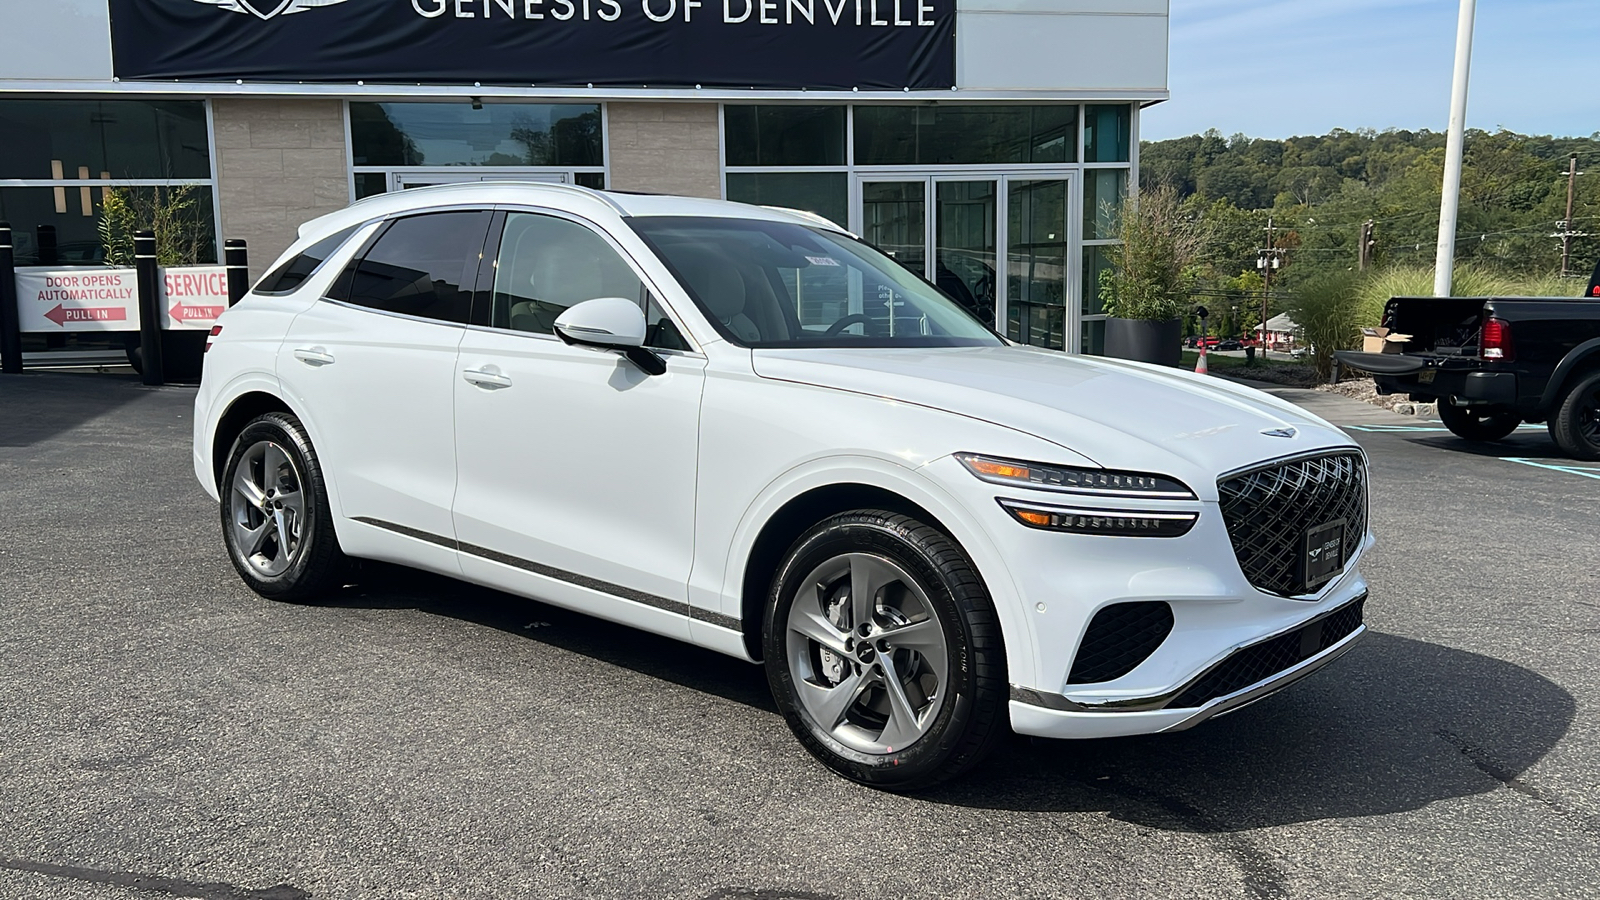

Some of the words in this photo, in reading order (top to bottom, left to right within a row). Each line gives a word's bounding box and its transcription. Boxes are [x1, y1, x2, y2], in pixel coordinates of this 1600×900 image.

[411, 0, 622, 22] GENESIS
[641, 0, 701, 23] OF
[722, 0, 935, 26] DENVILLE
[46, 276, 79, 288] DOOR
[82, 275, 122, 287] OPENS
[163, 273, 228, 297] SERVICE
[37, 288, 132, 301] AUTOMATICALLY
[66, 310, 93, 319] PULL
[97, 309, 108, 319] IN
[183, 307, 203, 318] PULL
[959, 646, 968, 673] TOUR
